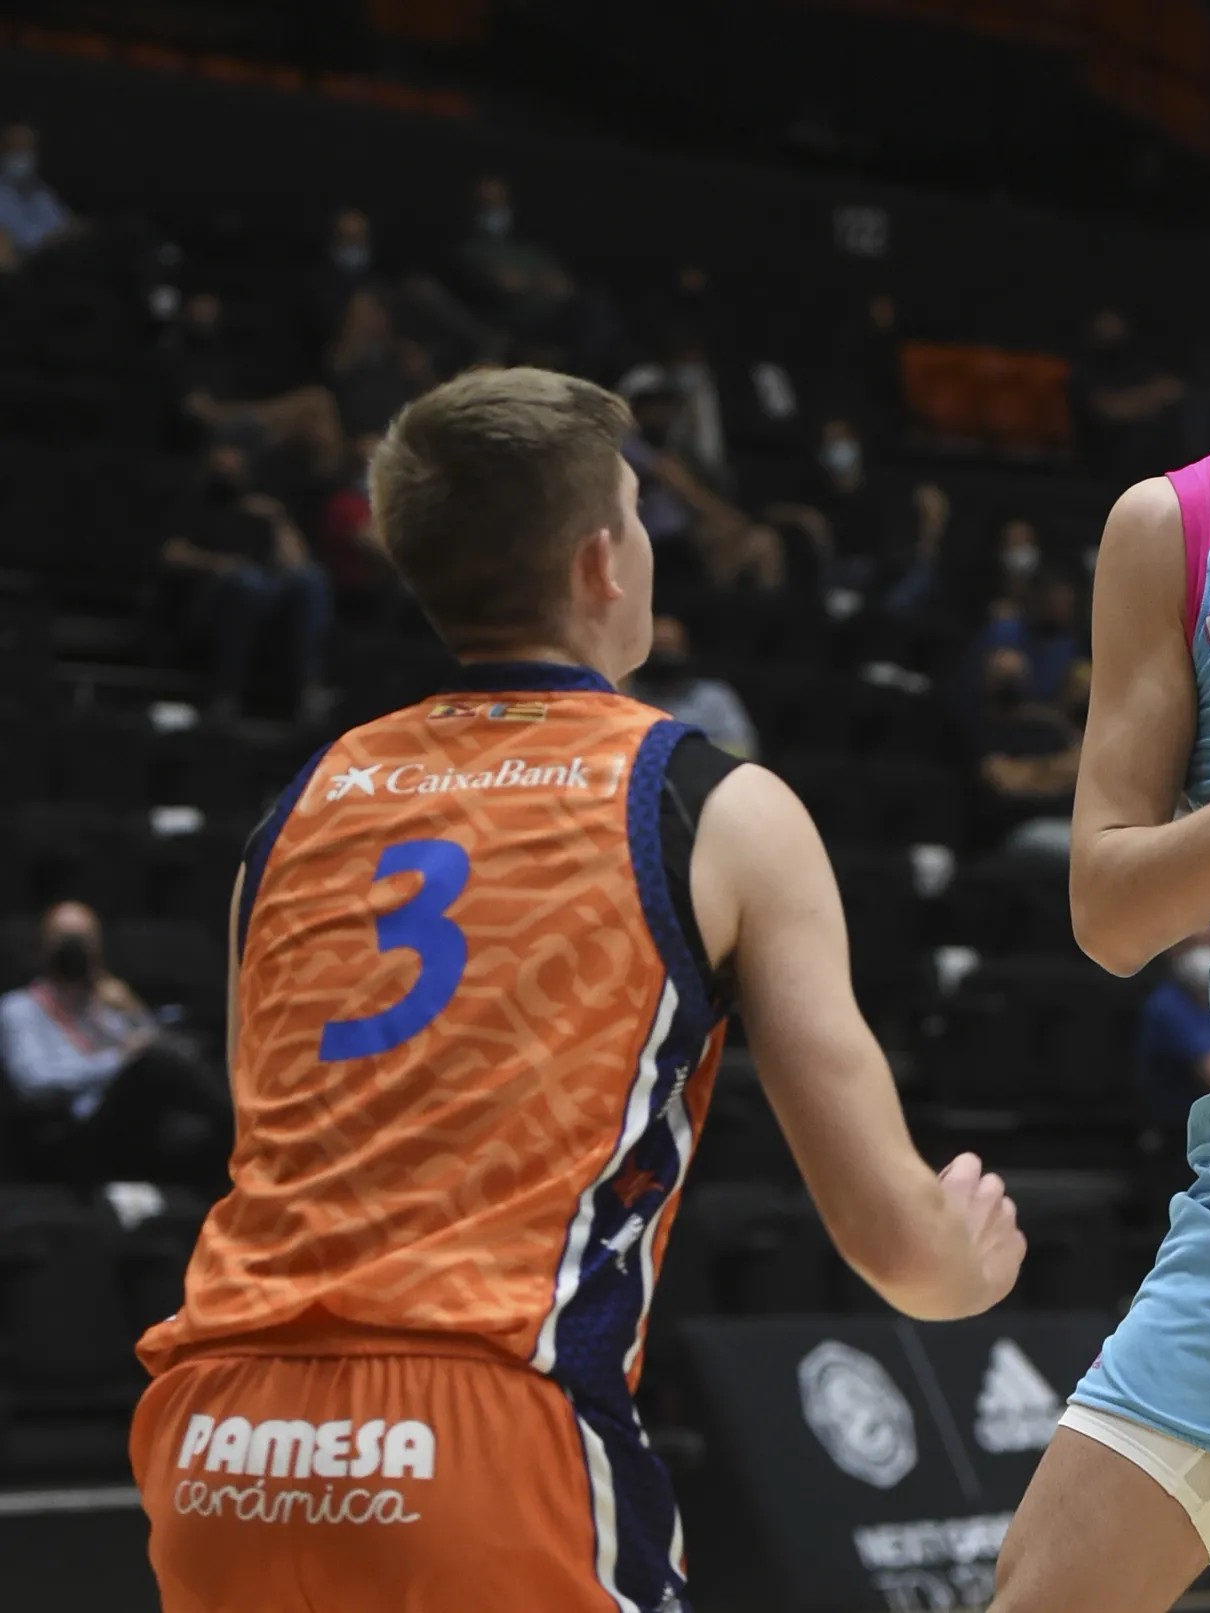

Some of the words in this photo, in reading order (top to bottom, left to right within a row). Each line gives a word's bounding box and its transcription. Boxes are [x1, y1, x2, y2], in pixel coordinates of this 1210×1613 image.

[386, 754, 590, 795] CaixaBank
[319, 838, 470, 1062] 3
[177, 1413, 434, 1480] PAMESA
[174, 1479, 421, 1524] cerámica
